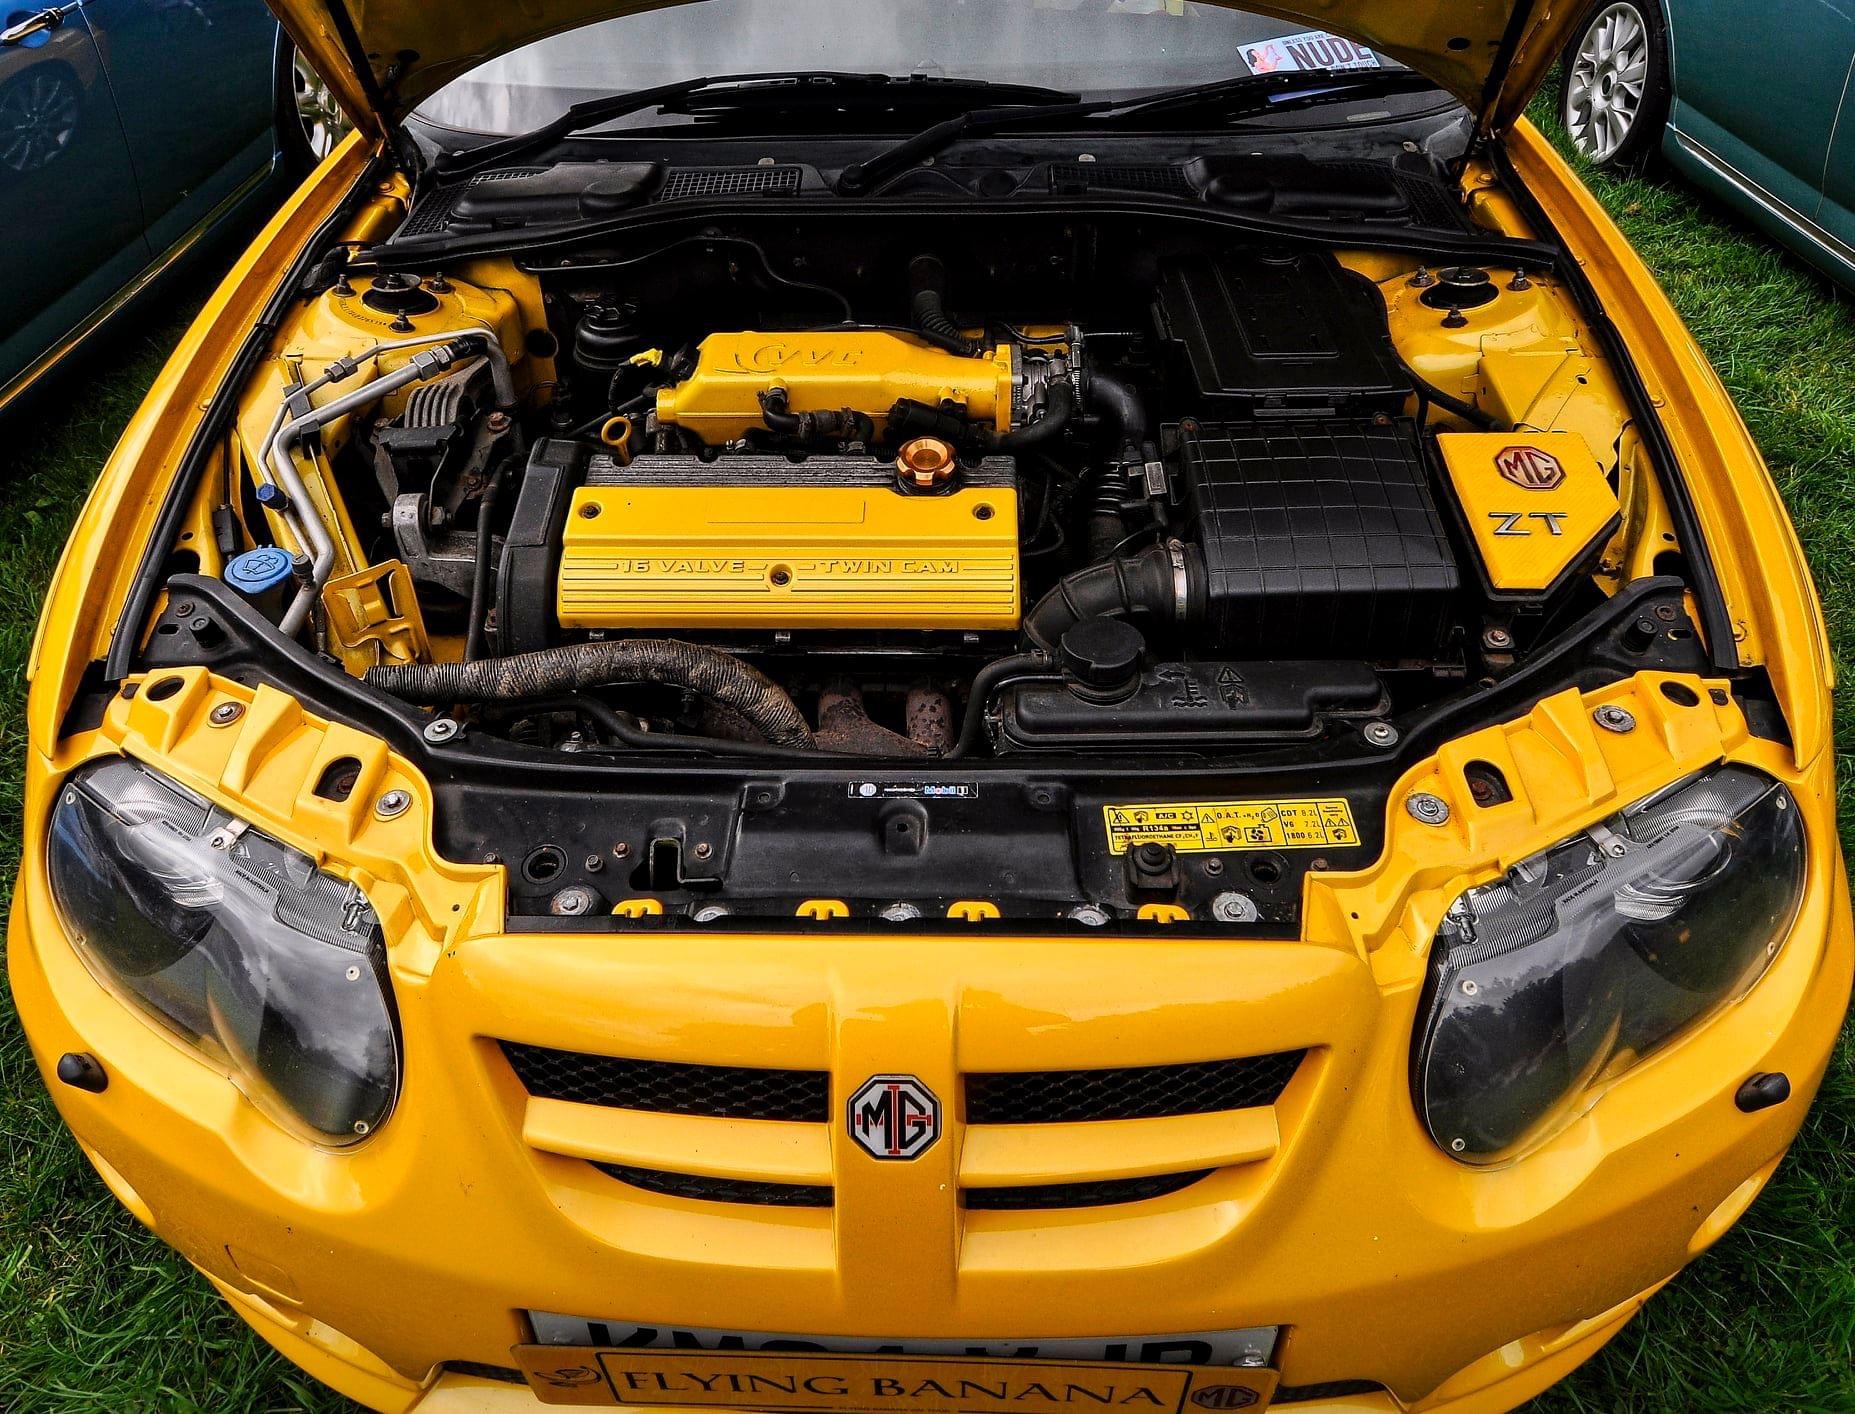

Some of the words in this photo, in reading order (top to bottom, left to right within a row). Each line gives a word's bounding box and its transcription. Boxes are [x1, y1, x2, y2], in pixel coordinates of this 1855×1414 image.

[1286, 38, 1373, 70] NUDE
[1500, 448, 1559, 487] MG
[1488, 512, 1568, 535] ZT
[623, 560, 650, 573] 16
[661, 560, 745, 573] VALVE
[820, 560, 892, 573] TWIN
[901, 560, 960, 573] CAM
[858, 1087, 930, 1153] MG
[621, 1372, 849, 1396] FLYING
[871, 1377, 1167, 1407] BANANA
[1196, 1386, 1255, 1408] MG
